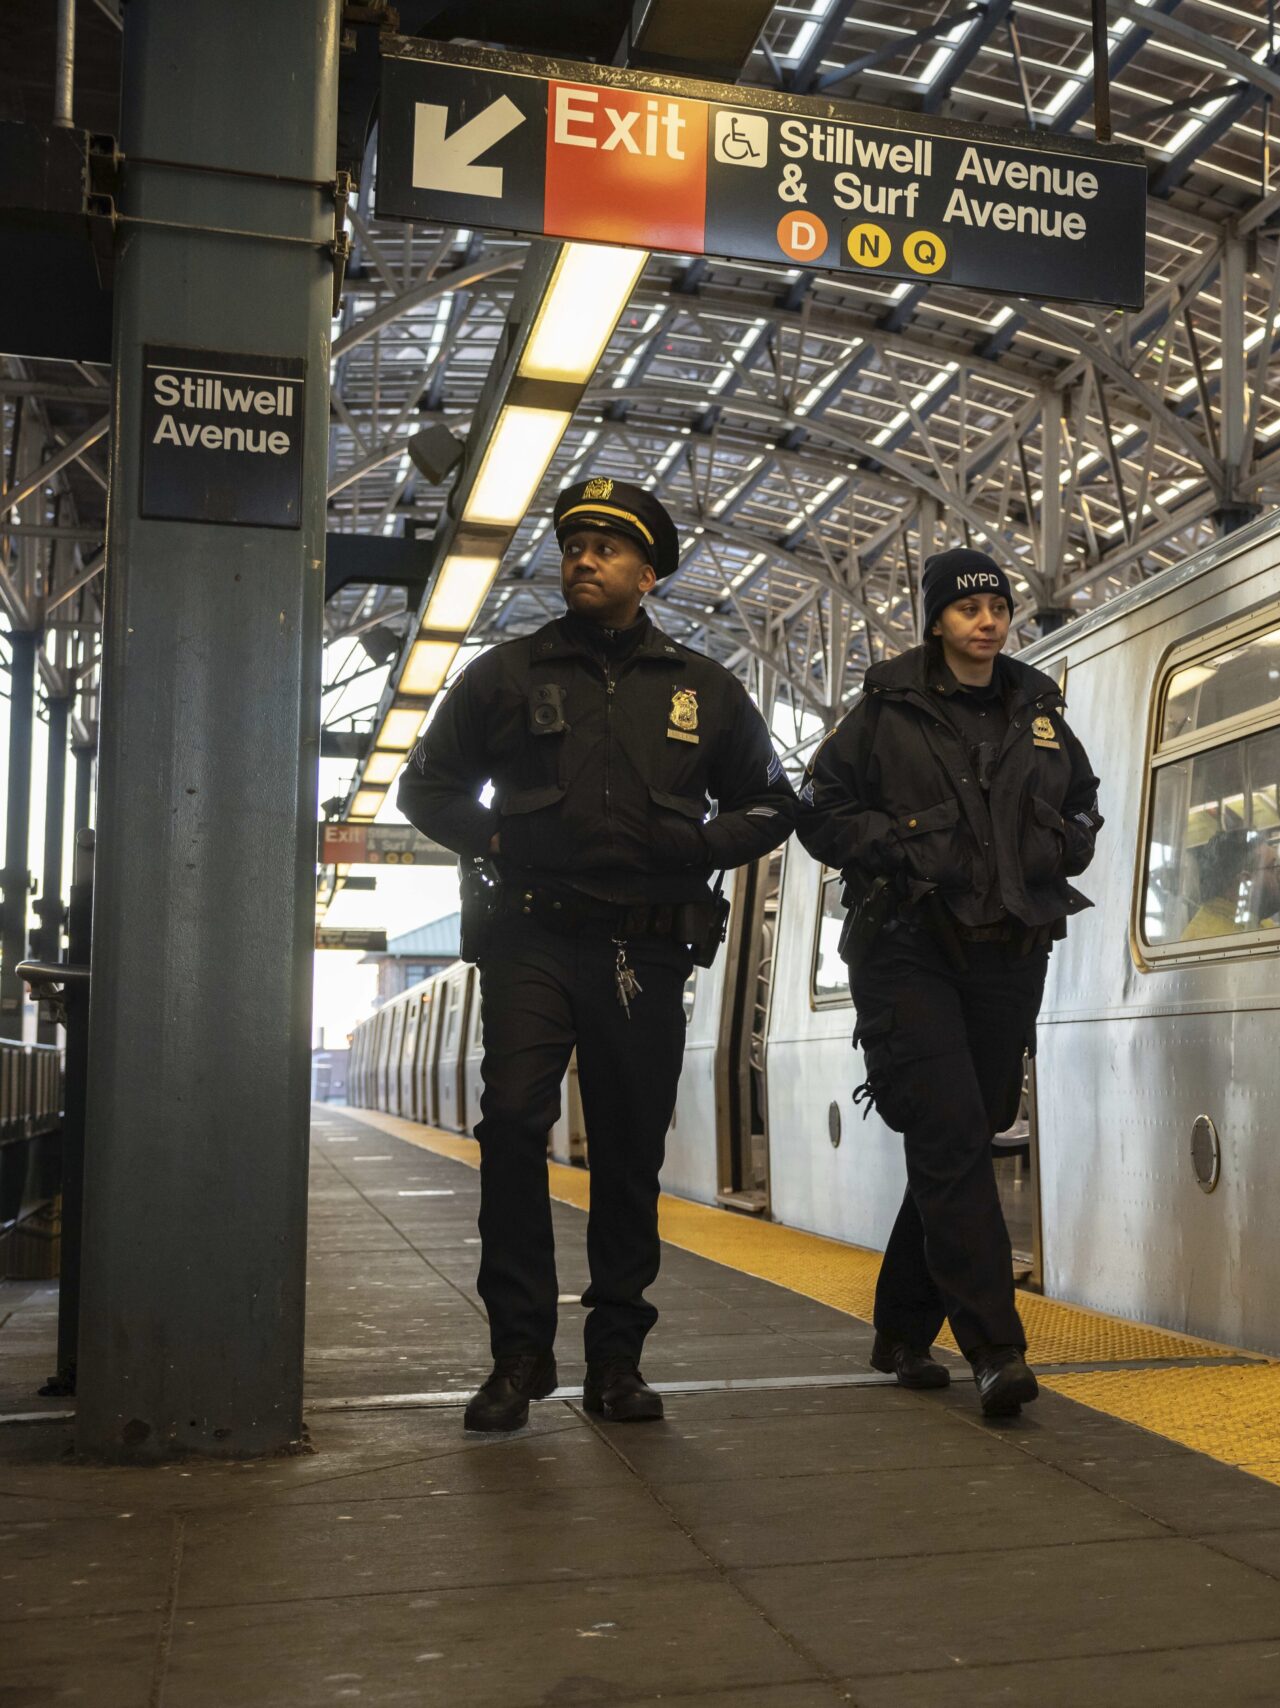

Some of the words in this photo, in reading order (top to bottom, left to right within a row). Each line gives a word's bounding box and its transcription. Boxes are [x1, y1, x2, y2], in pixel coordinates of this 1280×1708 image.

[554, 85, 687, 161] Exit
[778, 119, 933, 177] Stillwell
[955, 146, 1099, 200] Avenue
[777, 162, 808, 204] &
[832, 171, 920, 218] Surf
[942, 188, 1087, 241] Avenue
[790, 220, 817, 251] D
[859, 232, 881, 259] N
[913, 239, 936, 266] Q
[153, 373, 294, 418] Stillwell
[152, 413, 291, 456] Avenue
[956, 572, 1000, 591] NYPD
[324, 826, 361, 843] Exit
